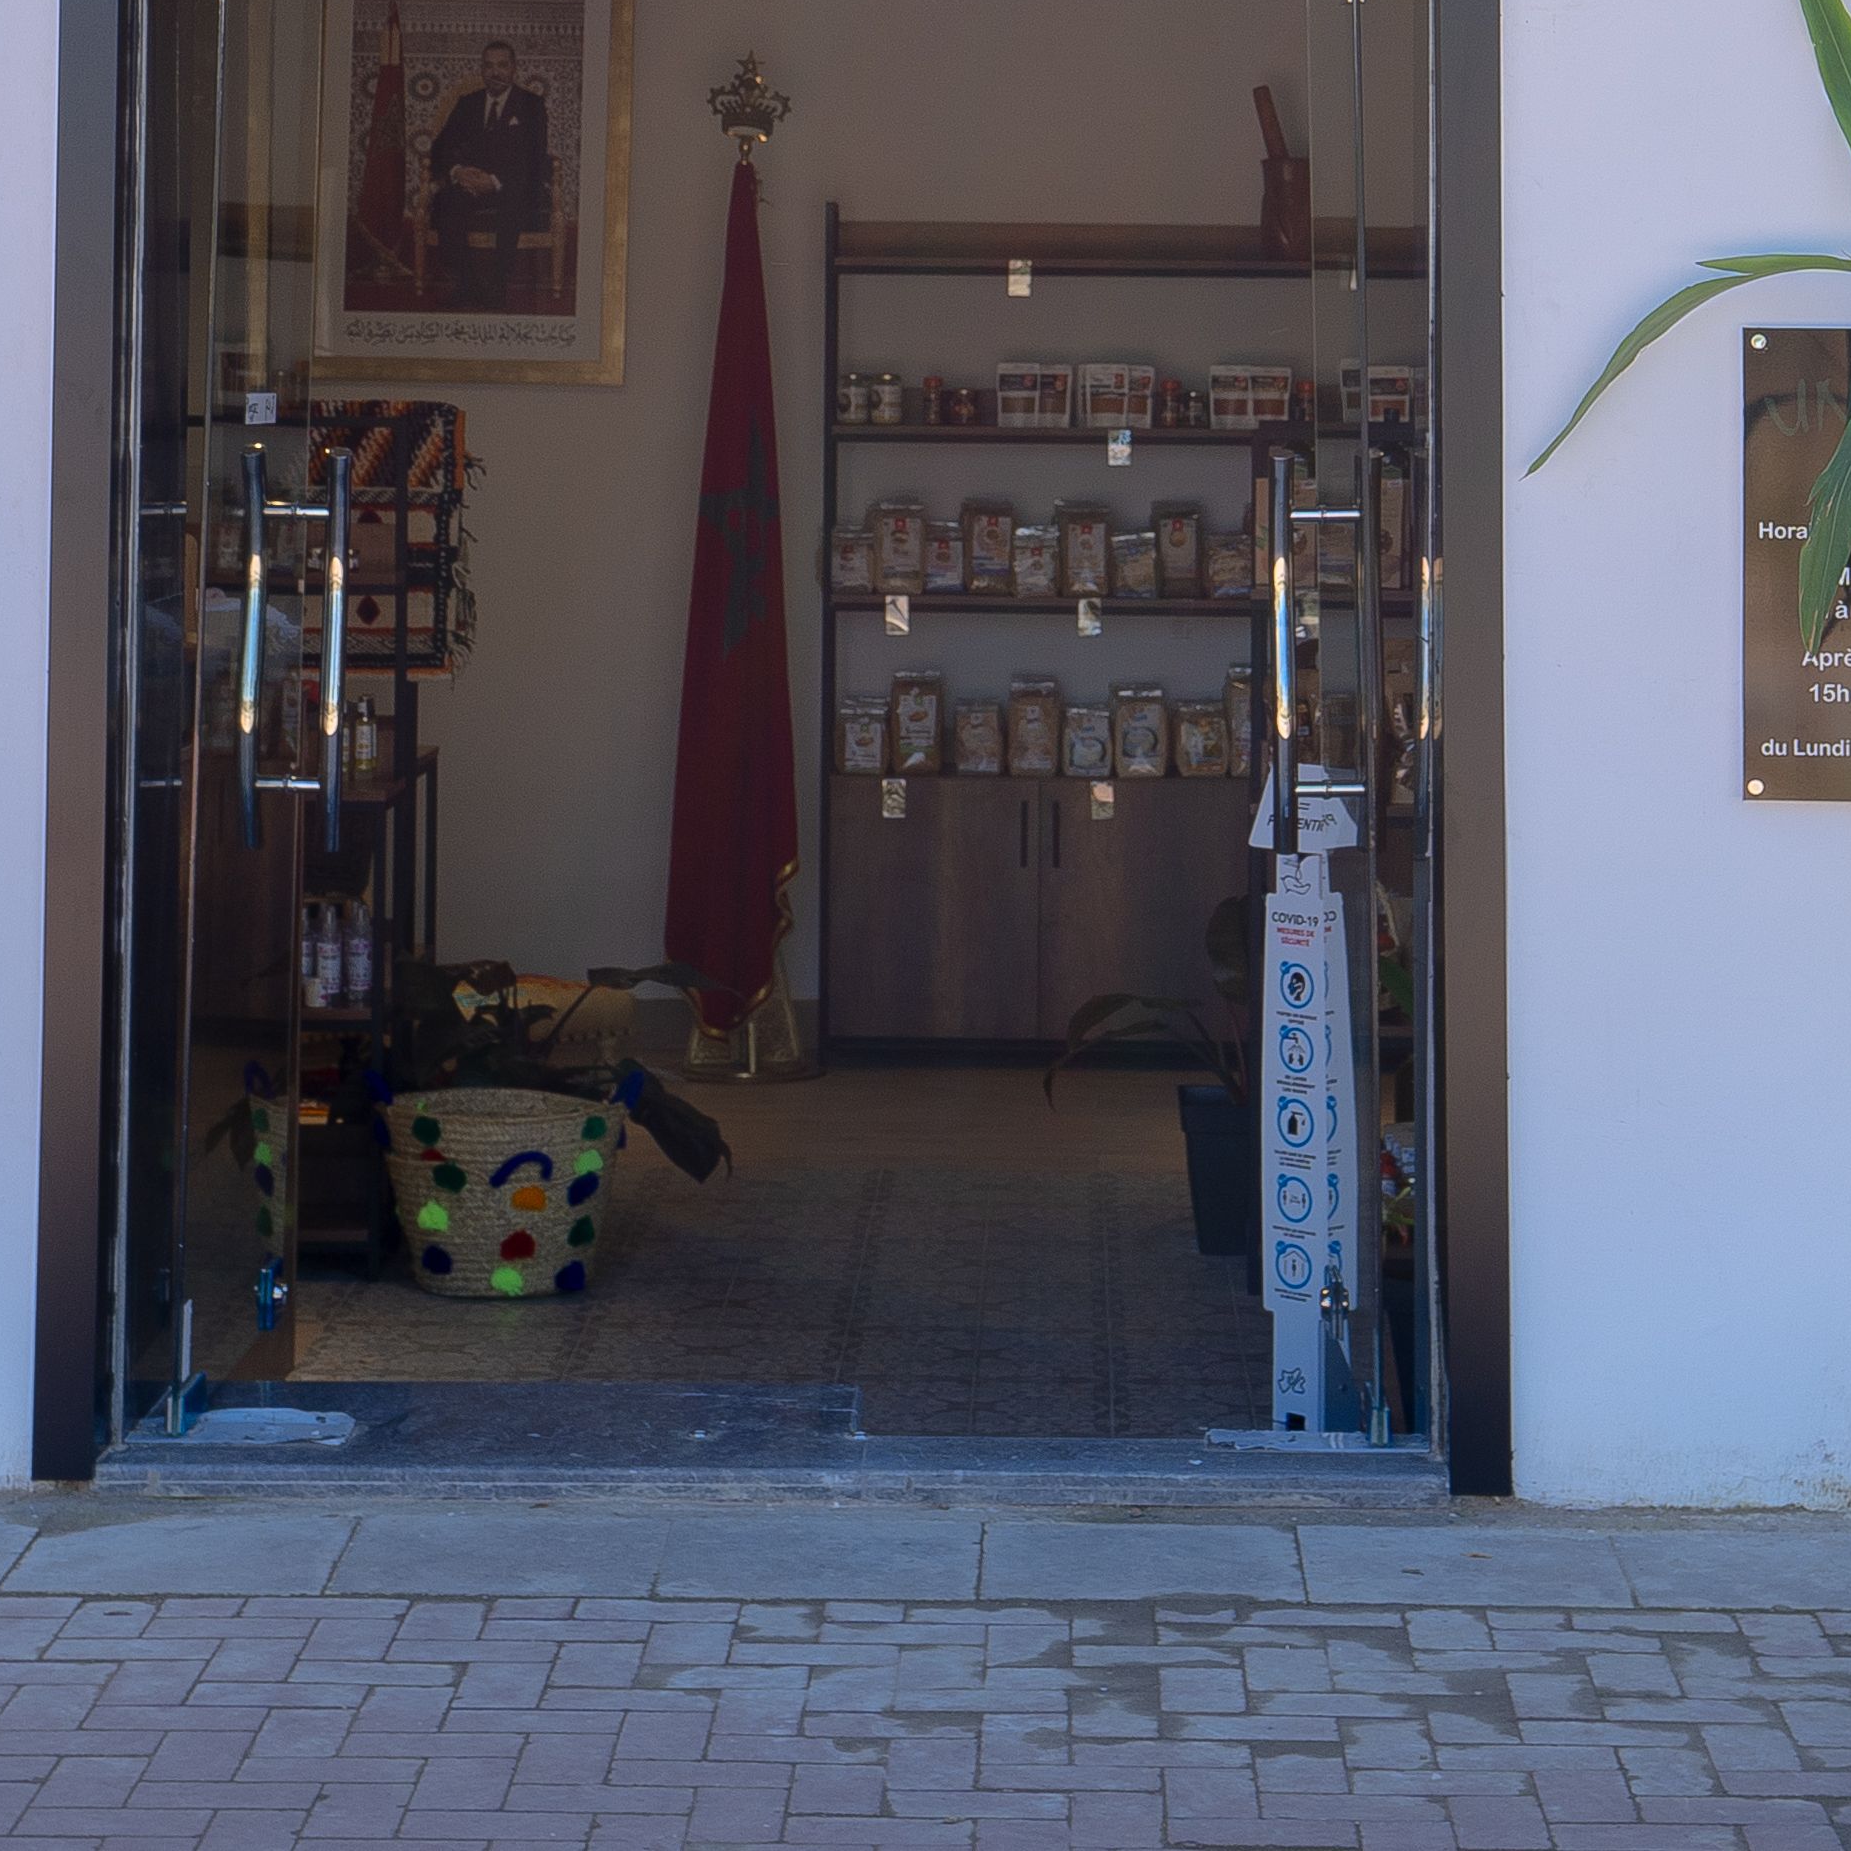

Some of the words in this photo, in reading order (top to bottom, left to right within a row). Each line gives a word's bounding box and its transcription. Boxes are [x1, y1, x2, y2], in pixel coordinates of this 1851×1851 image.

[1758, 521, 1811, 540] Hora
[1834, 600, 1849, 620] à
[1808, 683, 1850, 703] 15h
[1761, 738, 1788, 758] du
[1793, 738, 1851, 759] Lundi
[1272, 911, 1319, 927] COVID-19
